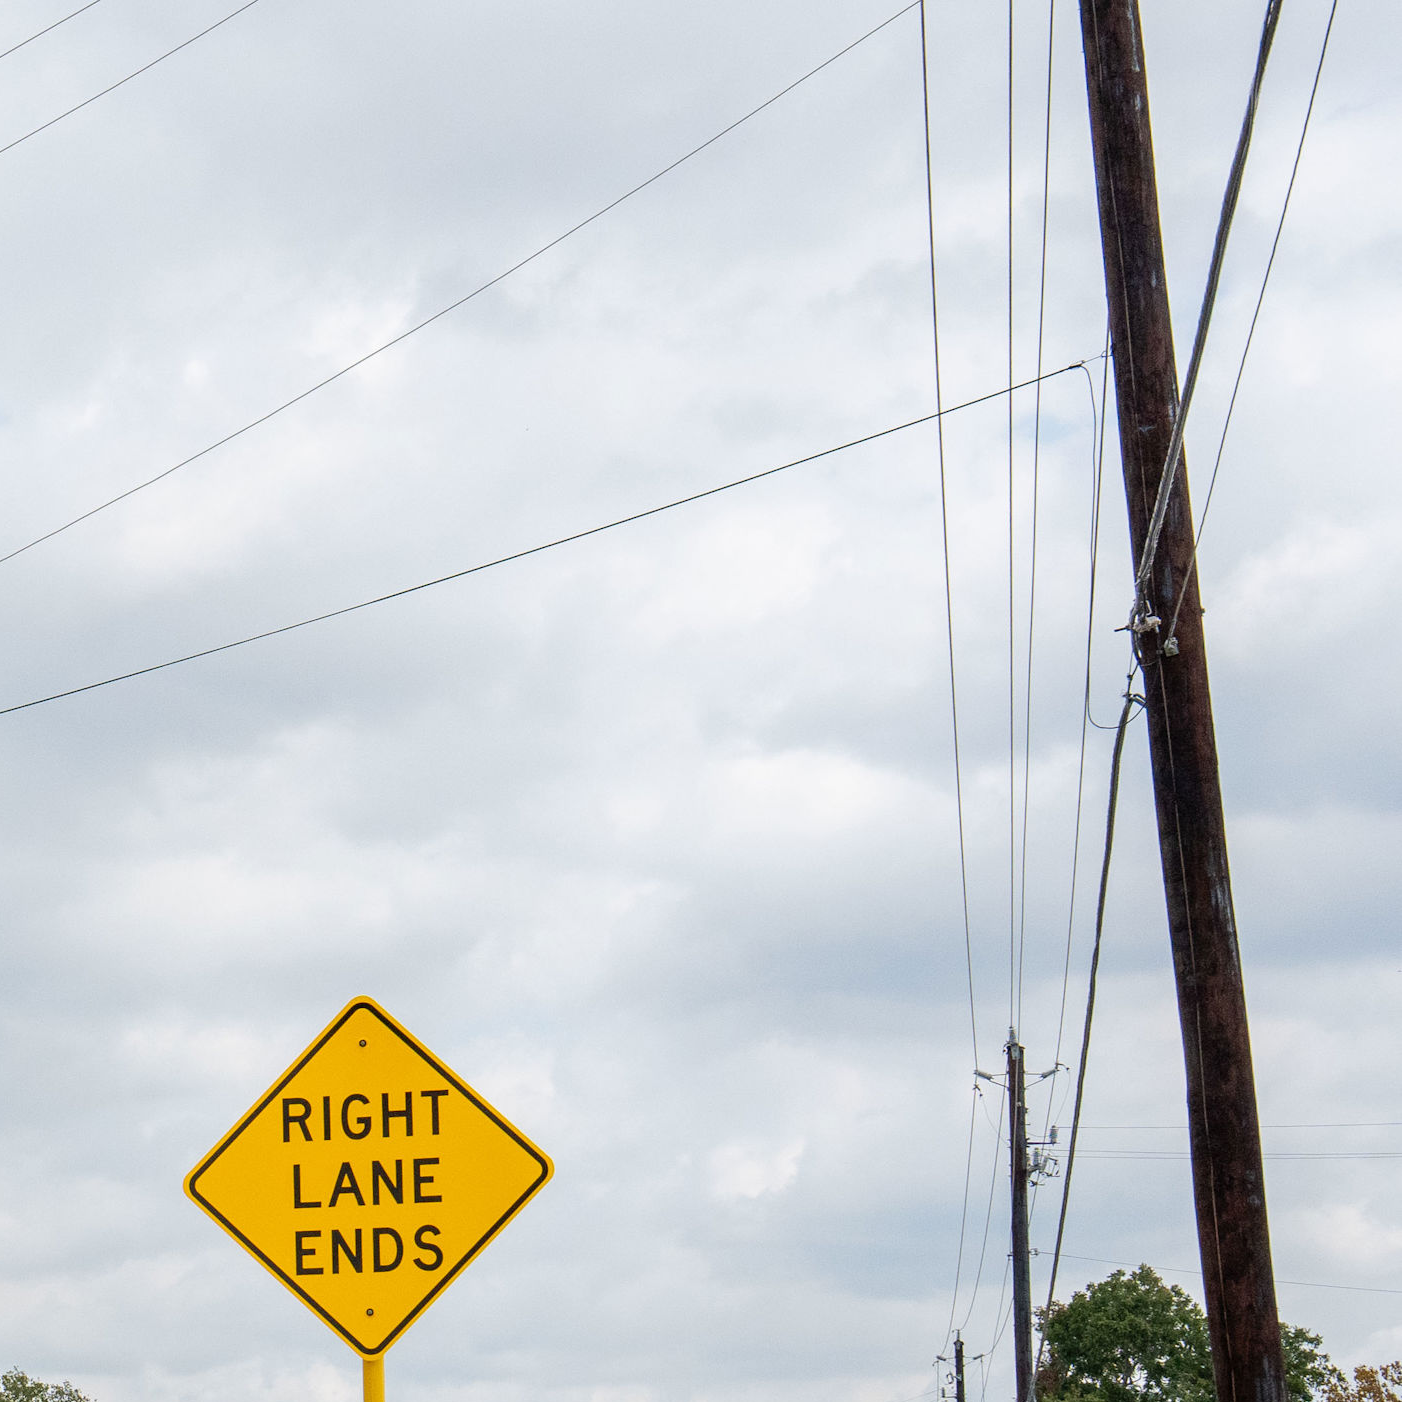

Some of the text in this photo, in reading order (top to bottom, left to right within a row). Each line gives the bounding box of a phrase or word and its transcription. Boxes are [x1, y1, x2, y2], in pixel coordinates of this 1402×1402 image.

[281, 1089, 450, 1143] RIGHT
[292, 1157, 443, 1209] LANE
[294, 1224, 444, 1276] ENDS
